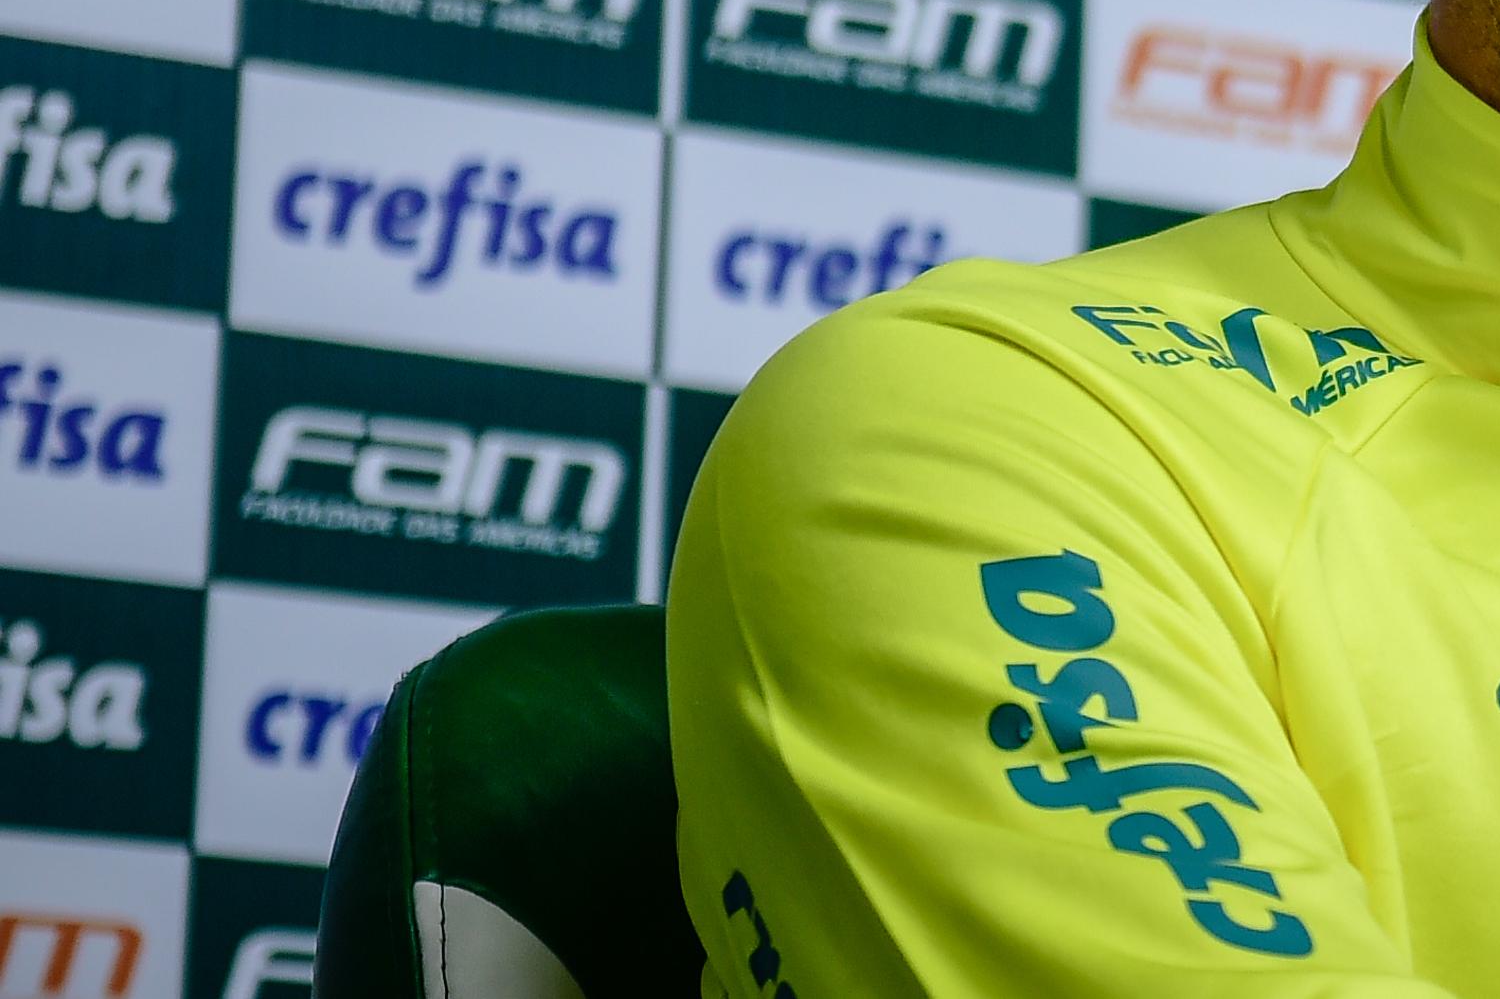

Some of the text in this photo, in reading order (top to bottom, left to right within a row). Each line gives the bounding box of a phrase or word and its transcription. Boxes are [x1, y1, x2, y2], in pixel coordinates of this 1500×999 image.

[271, 156, 619, 291] crefisa
[251, 406, 627, 533] Fam
[980, 548, 1314, 959] crefisa
